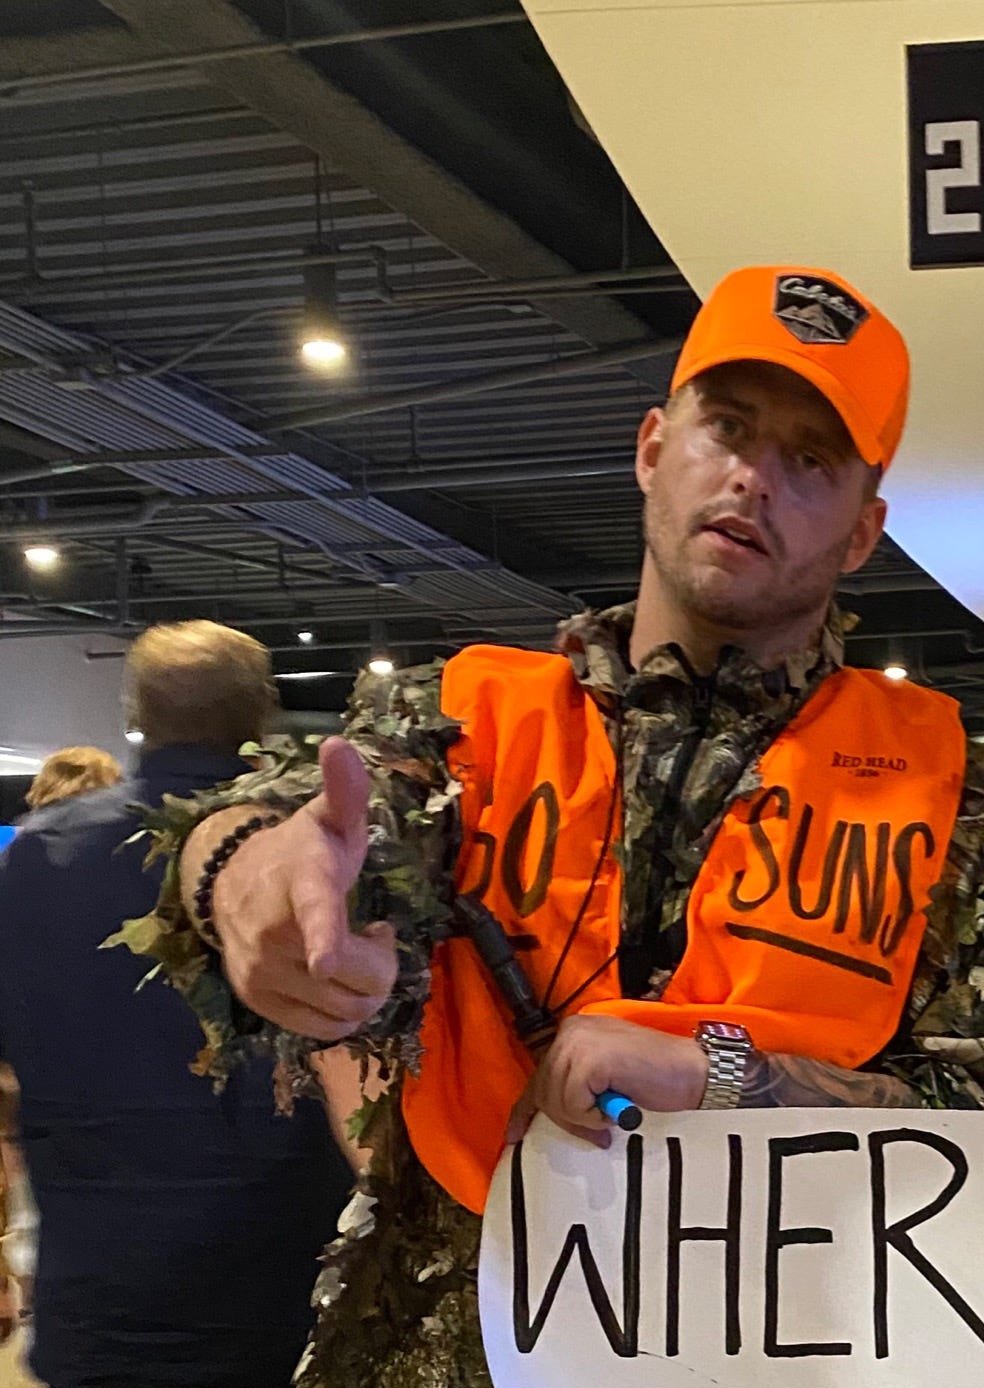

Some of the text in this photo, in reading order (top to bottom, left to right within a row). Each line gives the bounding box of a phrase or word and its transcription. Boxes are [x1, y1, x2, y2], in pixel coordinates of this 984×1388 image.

[831, 751, 907, 771] RED HEAD
[730, 784, 936, 957] SUNS
